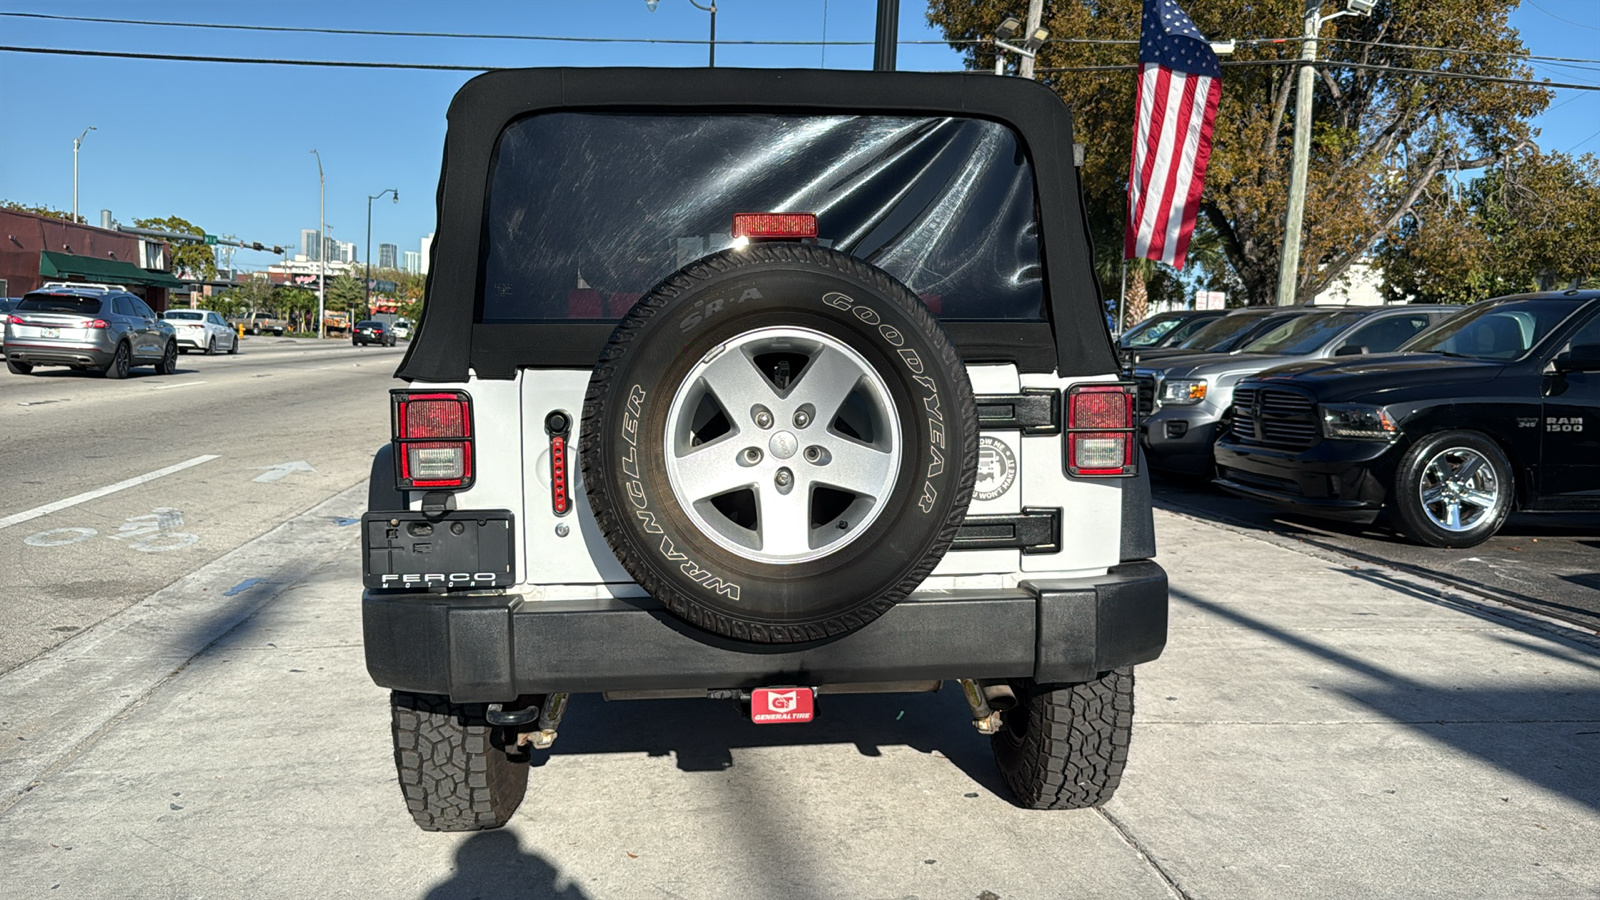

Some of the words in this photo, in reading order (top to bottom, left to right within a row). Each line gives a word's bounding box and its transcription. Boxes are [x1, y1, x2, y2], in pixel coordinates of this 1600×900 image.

[822, 291, 946, 514] GOODYEAR
[1546, 424, 1583, 432] 1500
[993, 440, 1006, 451] ME
[979, 489, 1003, 499] WON'T
[1002, 468, 1015, 489] MAKE
[622, 384, 741, 601] WRANGLER
[381, 572, 496, 582] FERCO
[772, 696, 794, 709] GT
[754, 713, 792, 721] GENERAL
[792, 712, 811, 720] TIRE
